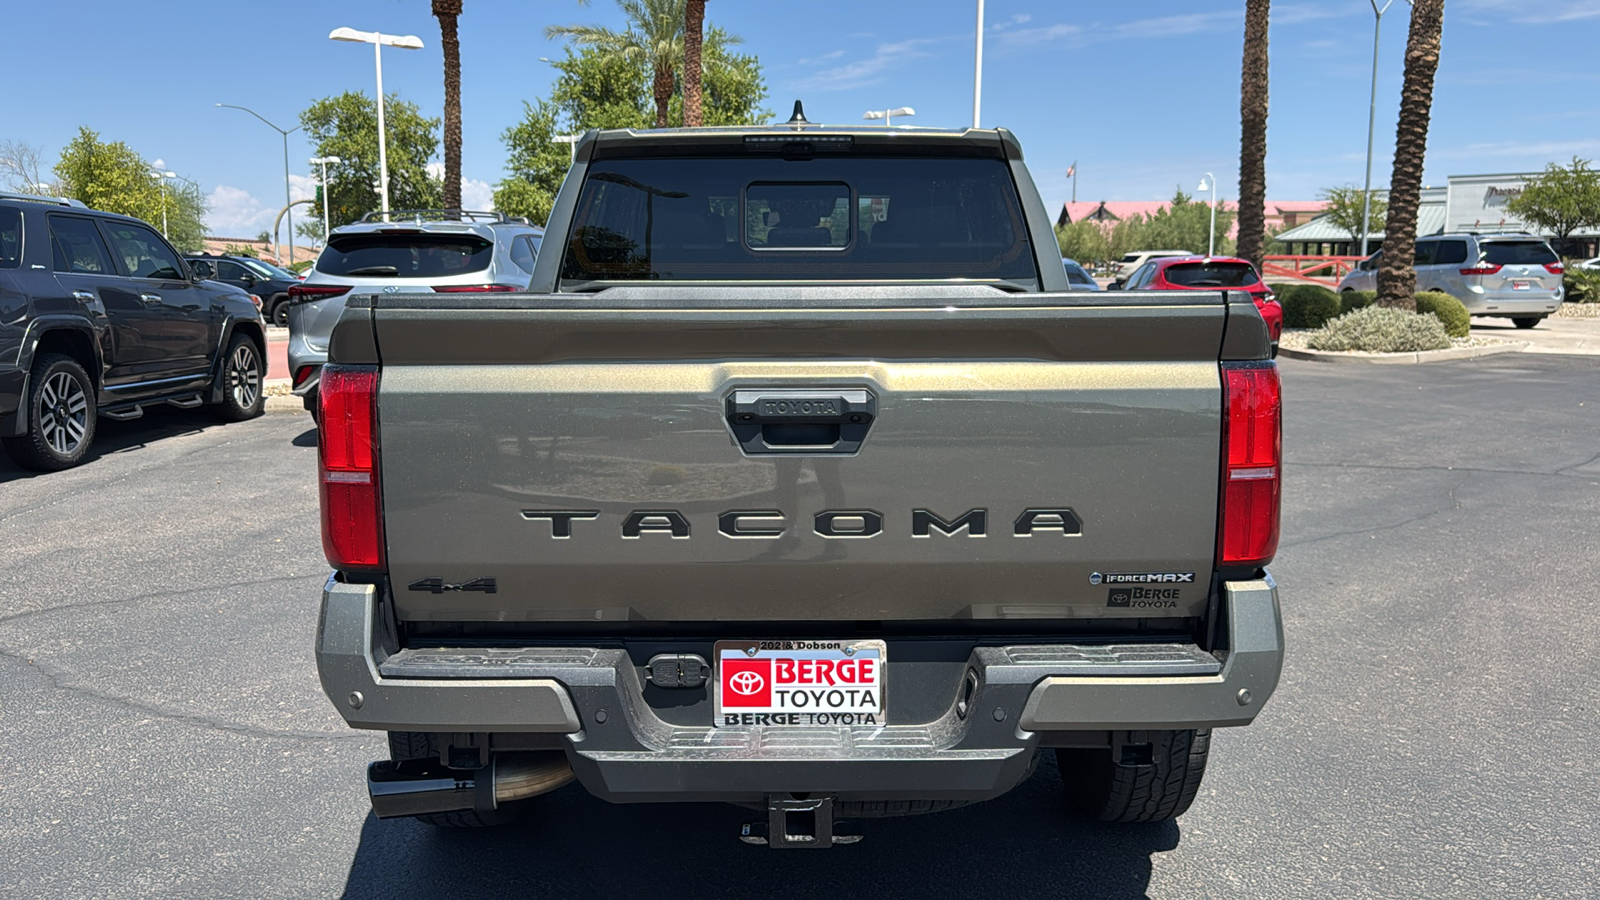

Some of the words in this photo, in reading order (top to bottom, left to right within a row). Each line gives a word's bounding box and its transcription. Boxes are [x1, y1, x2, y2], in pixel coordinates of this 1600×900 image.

[765, 401, 837, 414] TOYOTA
[520, 508, 1082, 539] TACOMA
[1132, 587, 1180, 600] BERGE
[1131, 600, 1177, 608] TOYOTA
[760, 641, 782, 650] 202
[785, 641, 794, 650] &
[799, 641, 840, 650] Dobson
[775, 658, 875, 687] BERGE
[775, 690, 877, 708] TOYOTA
[724, 713, 800, 726] BERGE
[807, 713, 877, 725] TOYOTA
